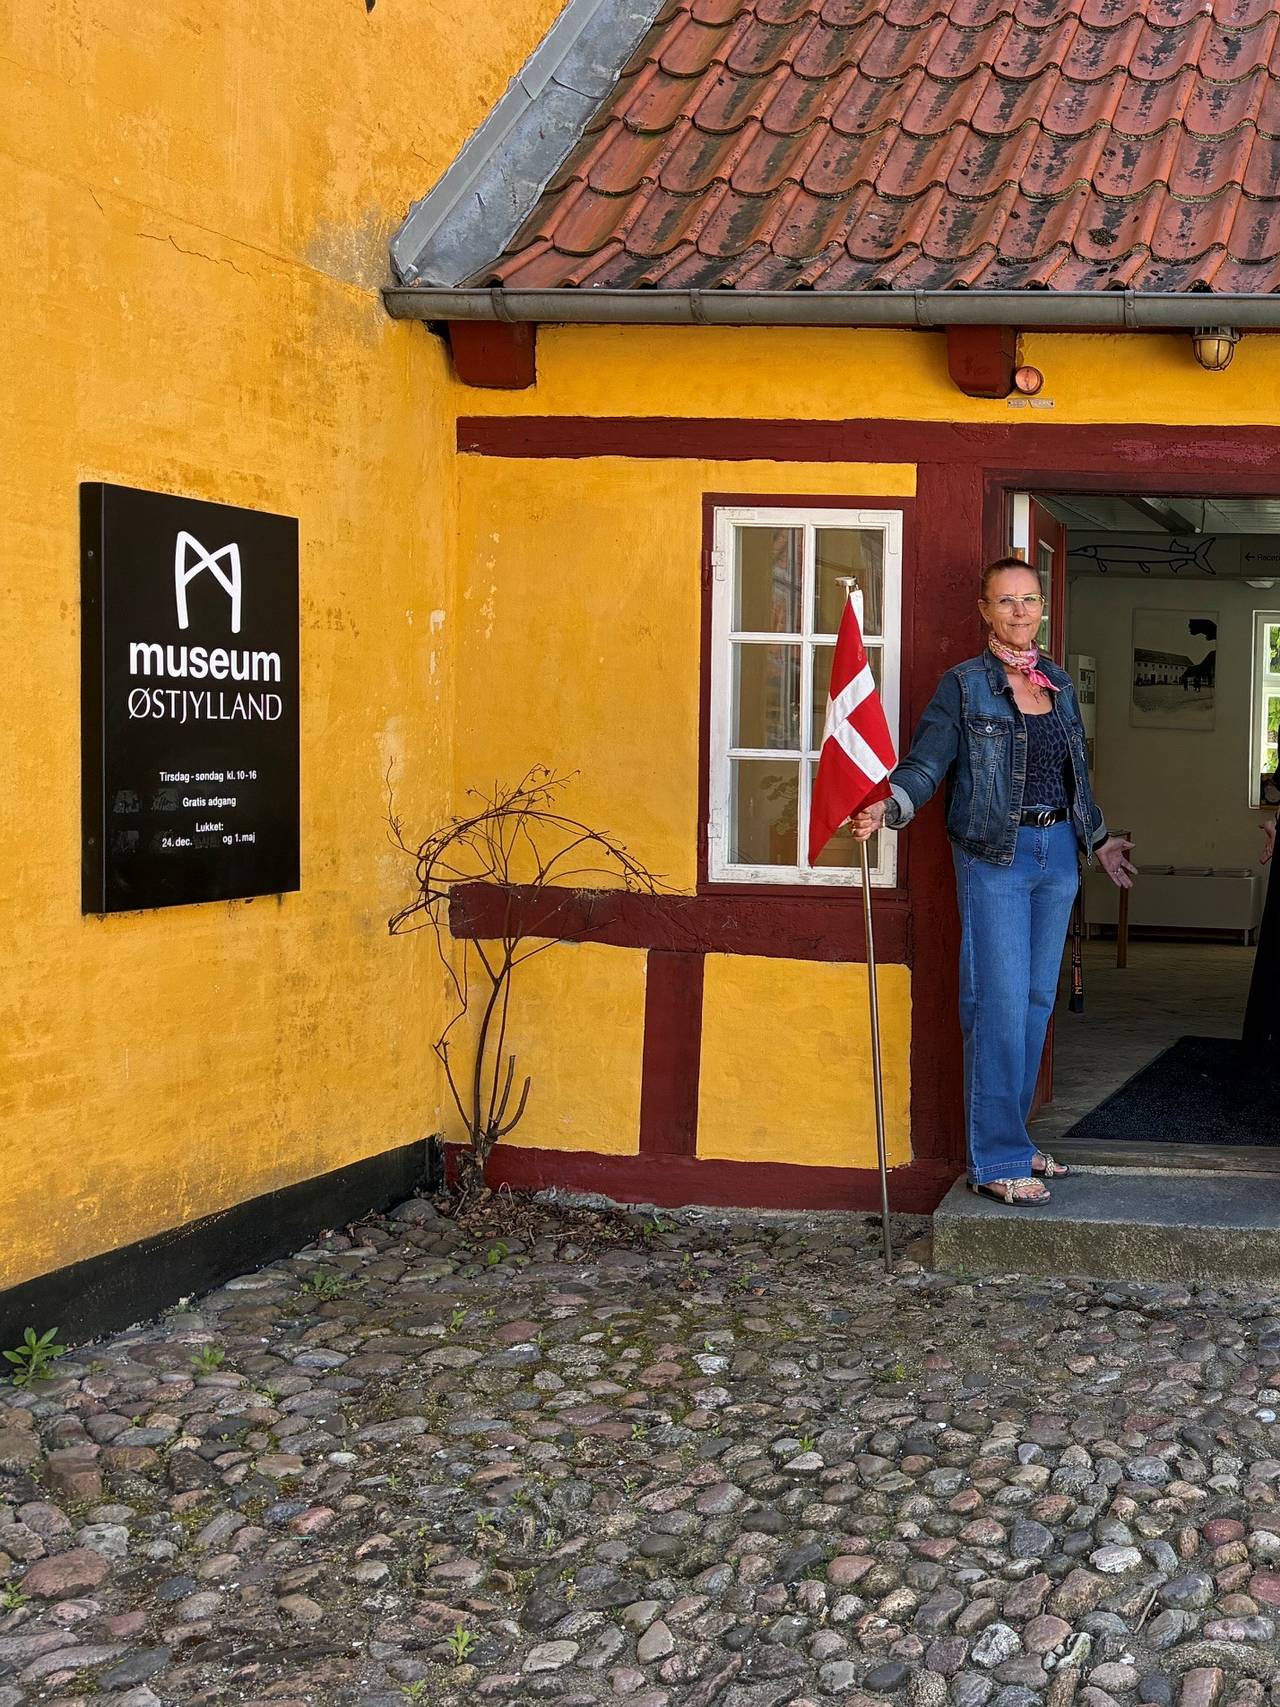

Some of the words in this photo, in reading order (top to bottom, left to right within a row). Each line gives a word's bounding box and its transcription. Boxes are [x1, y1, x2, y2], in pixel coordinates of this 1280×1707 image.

[129, 641, 281, 682] museum
[128, 687, 283, 724] ØSTJYLLAND
[236, 769, 257, 780] 10-16
[182, 797, 207, 808] Gratis
[208, 796, 237, 808] adgang
[195, 822, 224, 832] Lukket:
[222, 835, 233, 845] og
